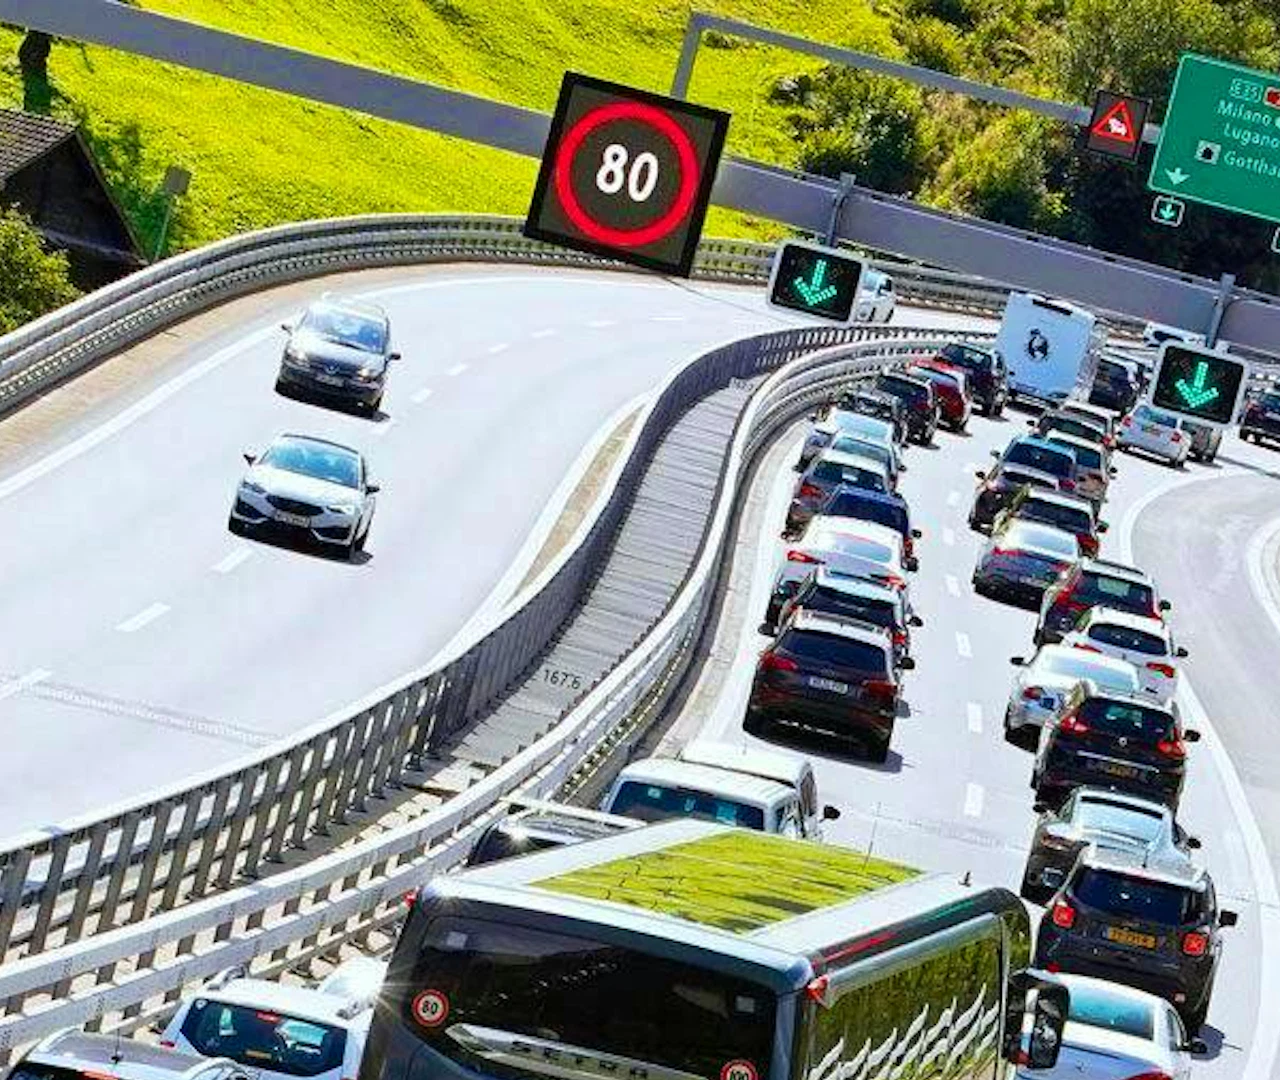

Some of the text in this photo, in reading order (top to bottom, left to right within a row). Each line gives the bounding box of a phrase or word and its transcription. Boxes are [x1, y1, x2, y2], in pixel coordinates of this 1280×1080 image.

[1232, 81, 1259, 99] E35
[1218, 100, 1272, 126] Milano
[1224, 122, 1280, 149] Lugano
[595, 143, 659, 202] 80
[422, 999, 439, 1016] 80
